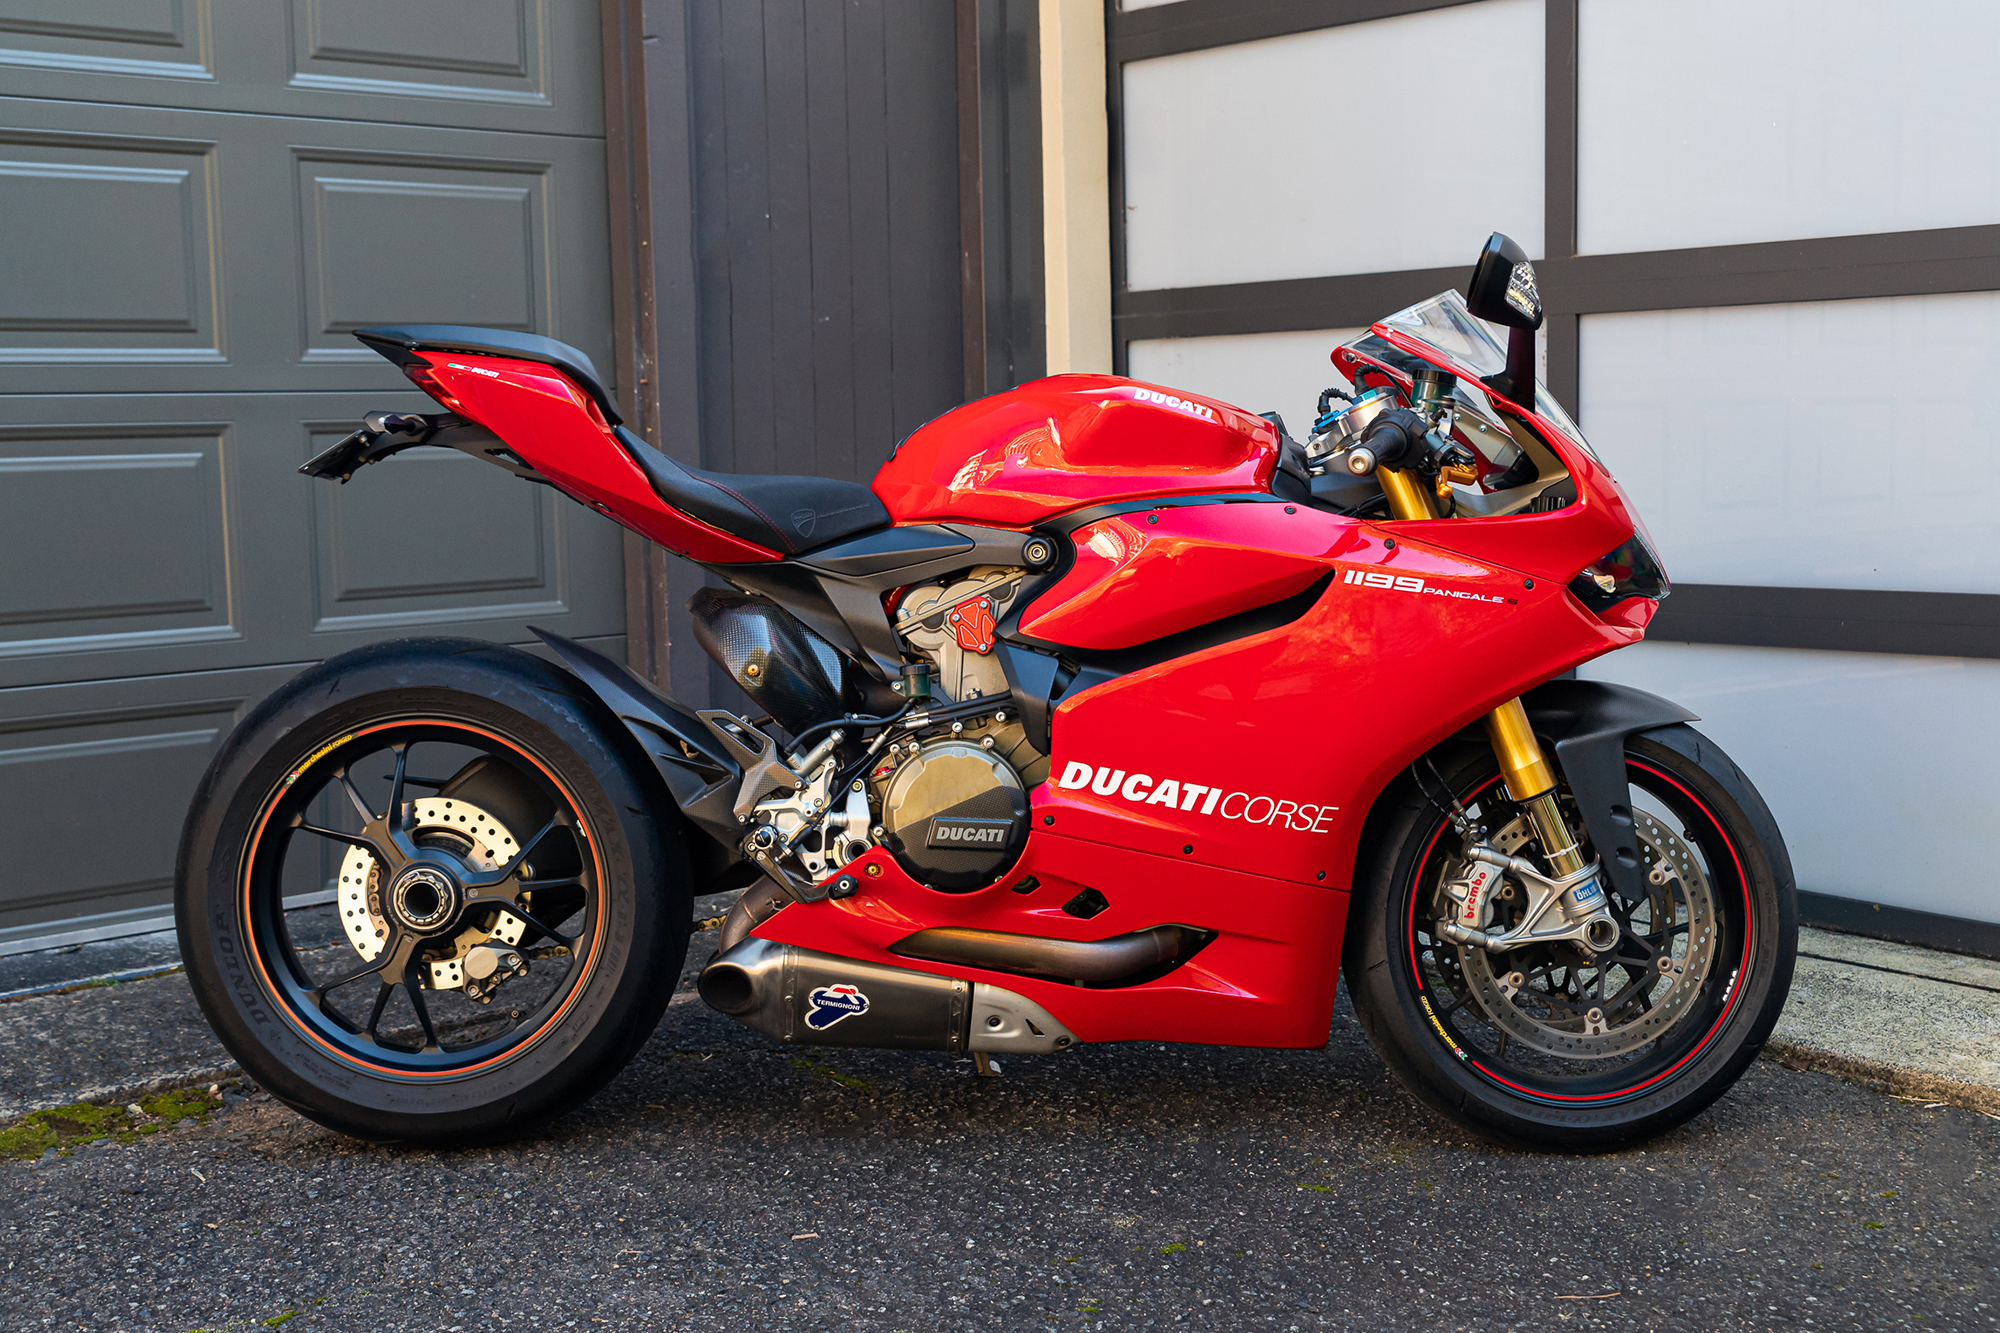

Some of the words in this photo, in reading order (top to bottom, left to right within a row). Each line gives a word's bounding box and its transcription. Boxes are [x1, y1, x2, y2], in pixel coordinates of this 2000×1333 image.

[471, 366, 500, 378] DUCATI
[1133, 388, 1214, 419] DUCATI
[1343, 569, 1425, 593] 1199
[1422, 587, 1505, 604] PANIGALE
[298, 742, 333, 774] marchesini
[1058, 760, 1223, 815] DUCATI
[1219, 791, 1340, 833] CORSE
[936, 826, 1005, 842] DUCATI
[1463, 871, 1487, 919] brembo
[214, 911, 272, 1029] DUNLOP
[816, 998, 861, 1011] TERMIGNONI
[1429, 1014, 1458, 1049] marchesini
